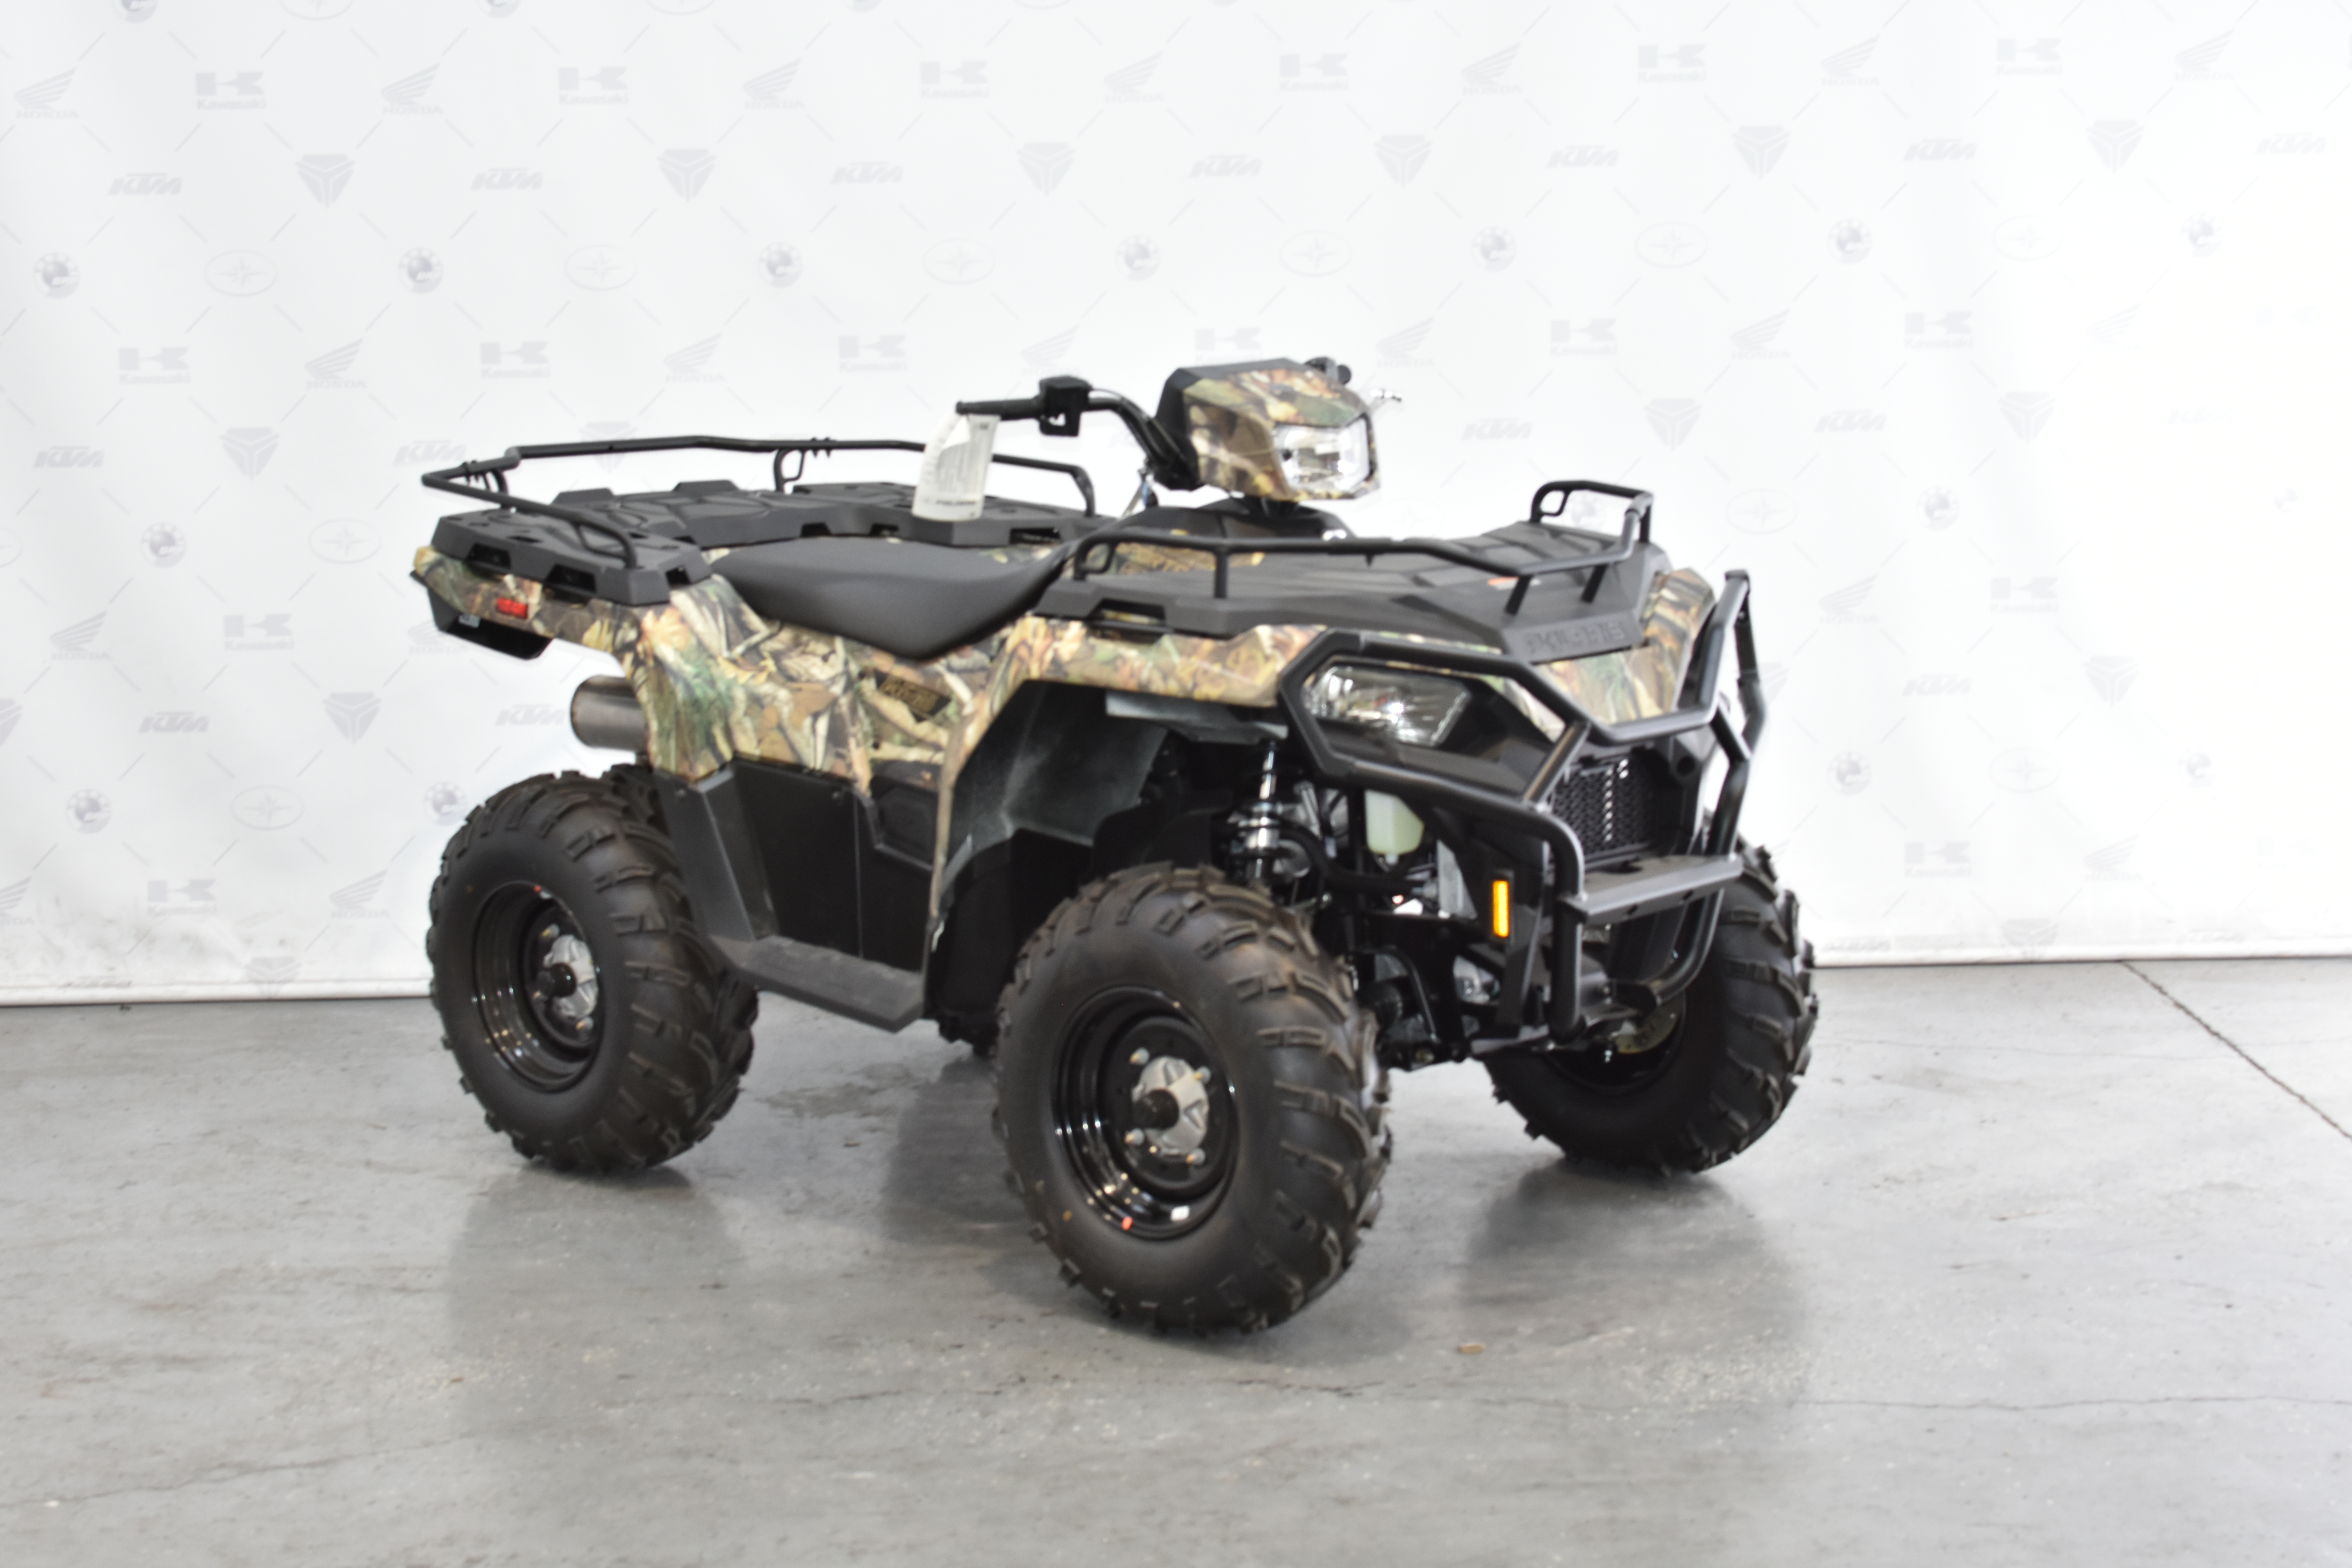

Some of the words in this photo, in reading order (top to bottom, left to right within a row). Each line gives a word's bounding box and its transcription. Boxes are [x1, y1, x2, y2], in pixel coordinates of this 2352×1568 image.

[1996, 64, 2063, 76] Kawasaki
[1637, 71, 1706, 83] Kawasaki
[1279, 80, 1349, 92] Kawasaki
[920, 86, 989, 99] Kawasaki
[1104, 93, 1165, 103] HONDA
[196, 98, 266, 111] Kawasaki
[558, 93, 630, 106] Kawasaki
[745, 100, 805, 109] HONDA
[16, 109, 80, 119] HONDA
[383, 105, 444, 114] HONDA
[1903, 138, 1976, 161] KTM
[2255, 132, 2327, 155] KTM
[1546, 145, 1619, 168] KTM
[1189, 154, 1261, 178] KTM
[470, 167, 543, 191] KTM
[830, 162, 903, 185] KTM
[108, 172, 182, 195] KTM
[1904, 336, 1974, 349] Kawasaki
[1550, 345, 1618, 356] Kawasaki
[839, 361, 908, 372] Kawasaki
[119, 373, 191, 384] Kawasaki
[481, 367, 550, 379] Kawasaki
[664, 373, 726, 383] HONDA
[307, 379, 367, 389] HONDA
[1814, 410, 1886, 432] KTM
[1461, 418, 1532, 441] KTM
[34, 446, 103, 468] KTM
[392, 440, 466, 466] KTM
[1990, 603, 2060, 613] Kawasaki
[224, 640, 294, 651] Kawasaki
[408, 646, 467, 655] HONDA
[51, 652, 112, 661] HONDA
[1901, 675, 1972, 696] KTM
[495, 704, 566, 725] KTM
[139, 711, 209, 733] KTM
[1904, 866, 1972, 877] Kawasaki
[331, 910, 390, 920] HONDA
